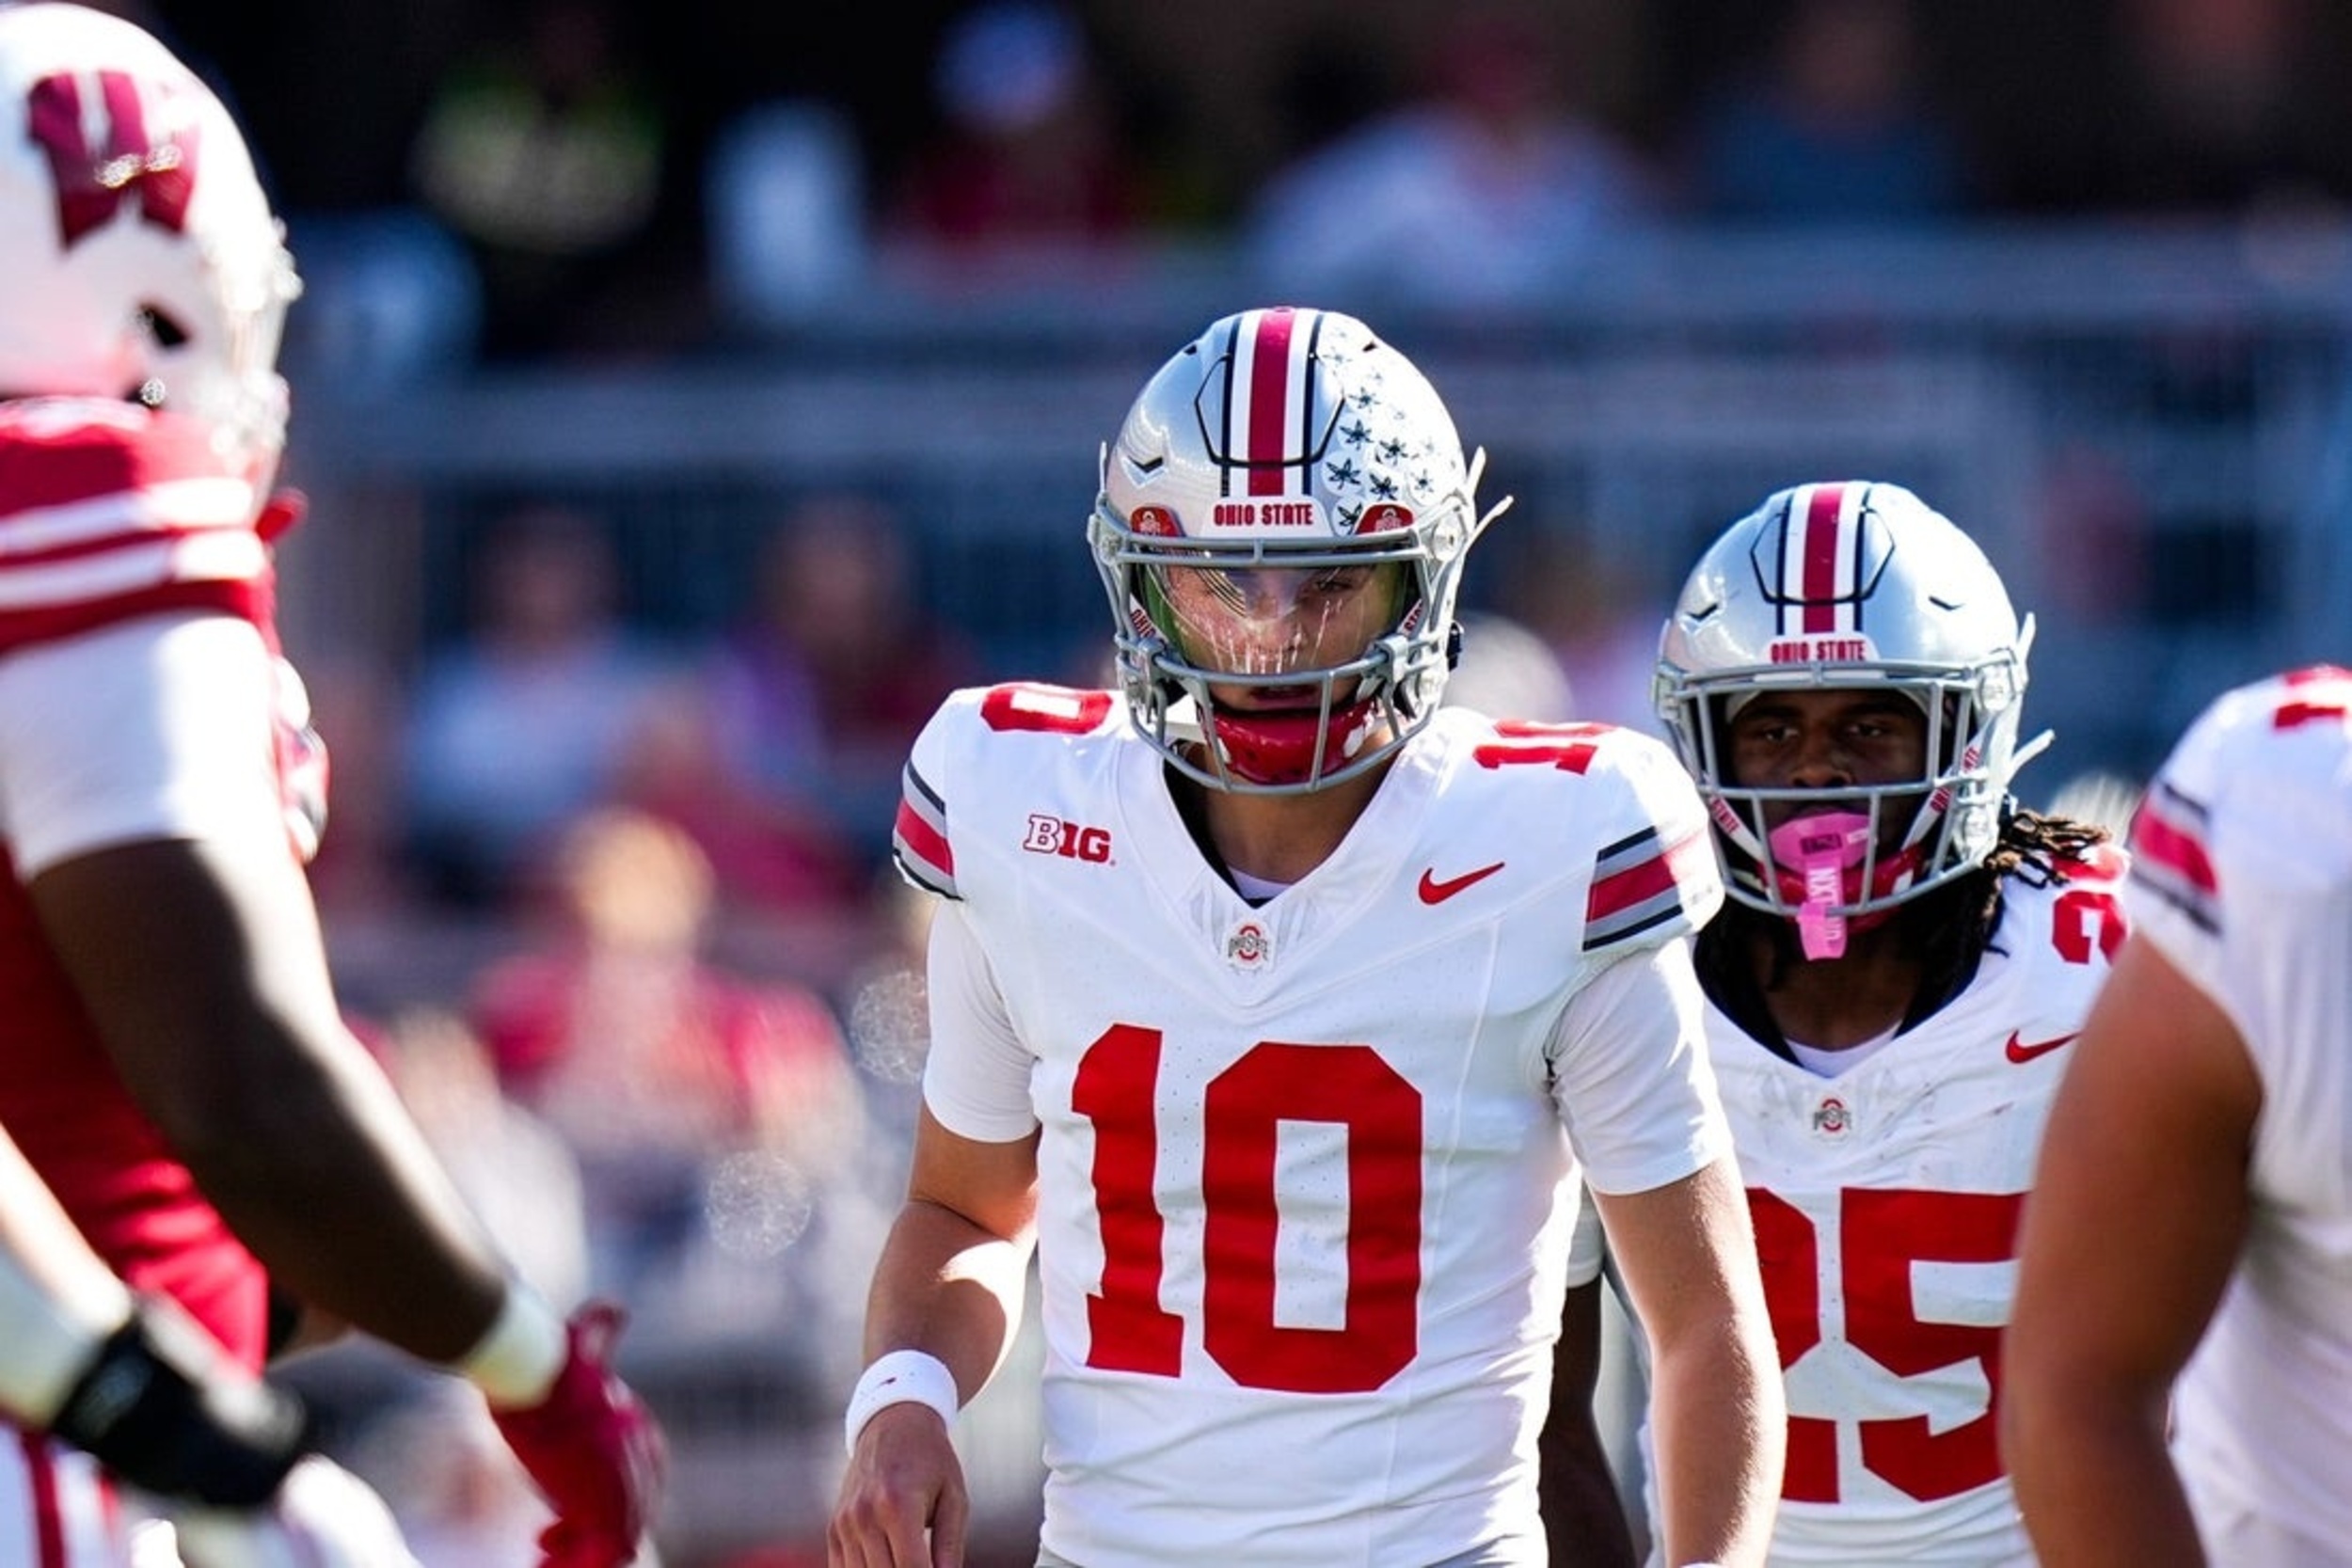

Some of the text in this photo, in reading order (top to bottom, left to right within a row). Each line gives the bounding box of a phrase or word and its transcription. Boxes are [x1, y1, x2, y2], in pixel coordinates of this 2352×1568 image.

[27, 70, 199, 248] W
[1214, 503, 1312, 526] OHIO STATE
[1771, 640, 1866, 663] OHIO STATE
[1071, 1022, 1422, 1394] 10
[1744, 1186, 2034, 1505] 25
